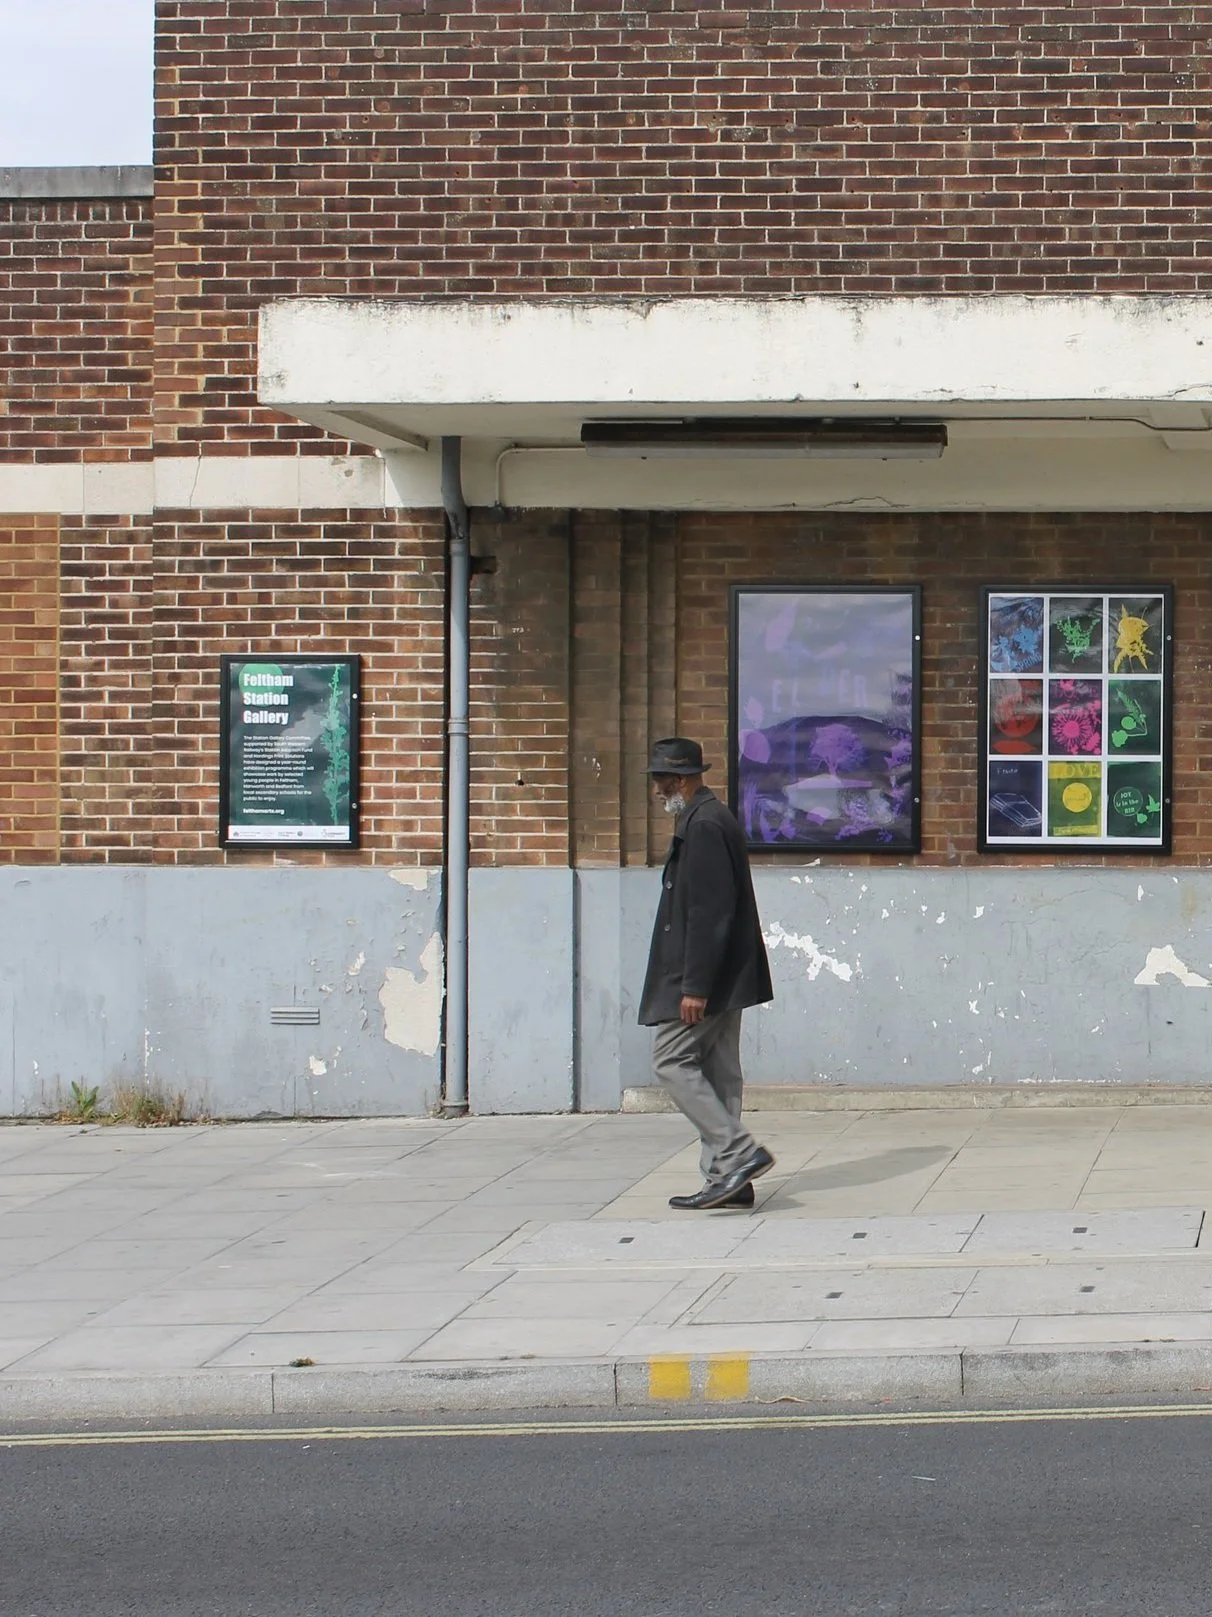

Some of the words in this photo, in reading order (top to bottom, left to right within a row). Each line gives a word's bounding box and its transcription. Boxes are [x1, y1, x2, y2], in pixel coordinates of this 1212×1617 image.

[243, 673, 294, 687] Feltham
[243, 691, 289, 706] Station
[243, 710, 289, 725] Gallery
